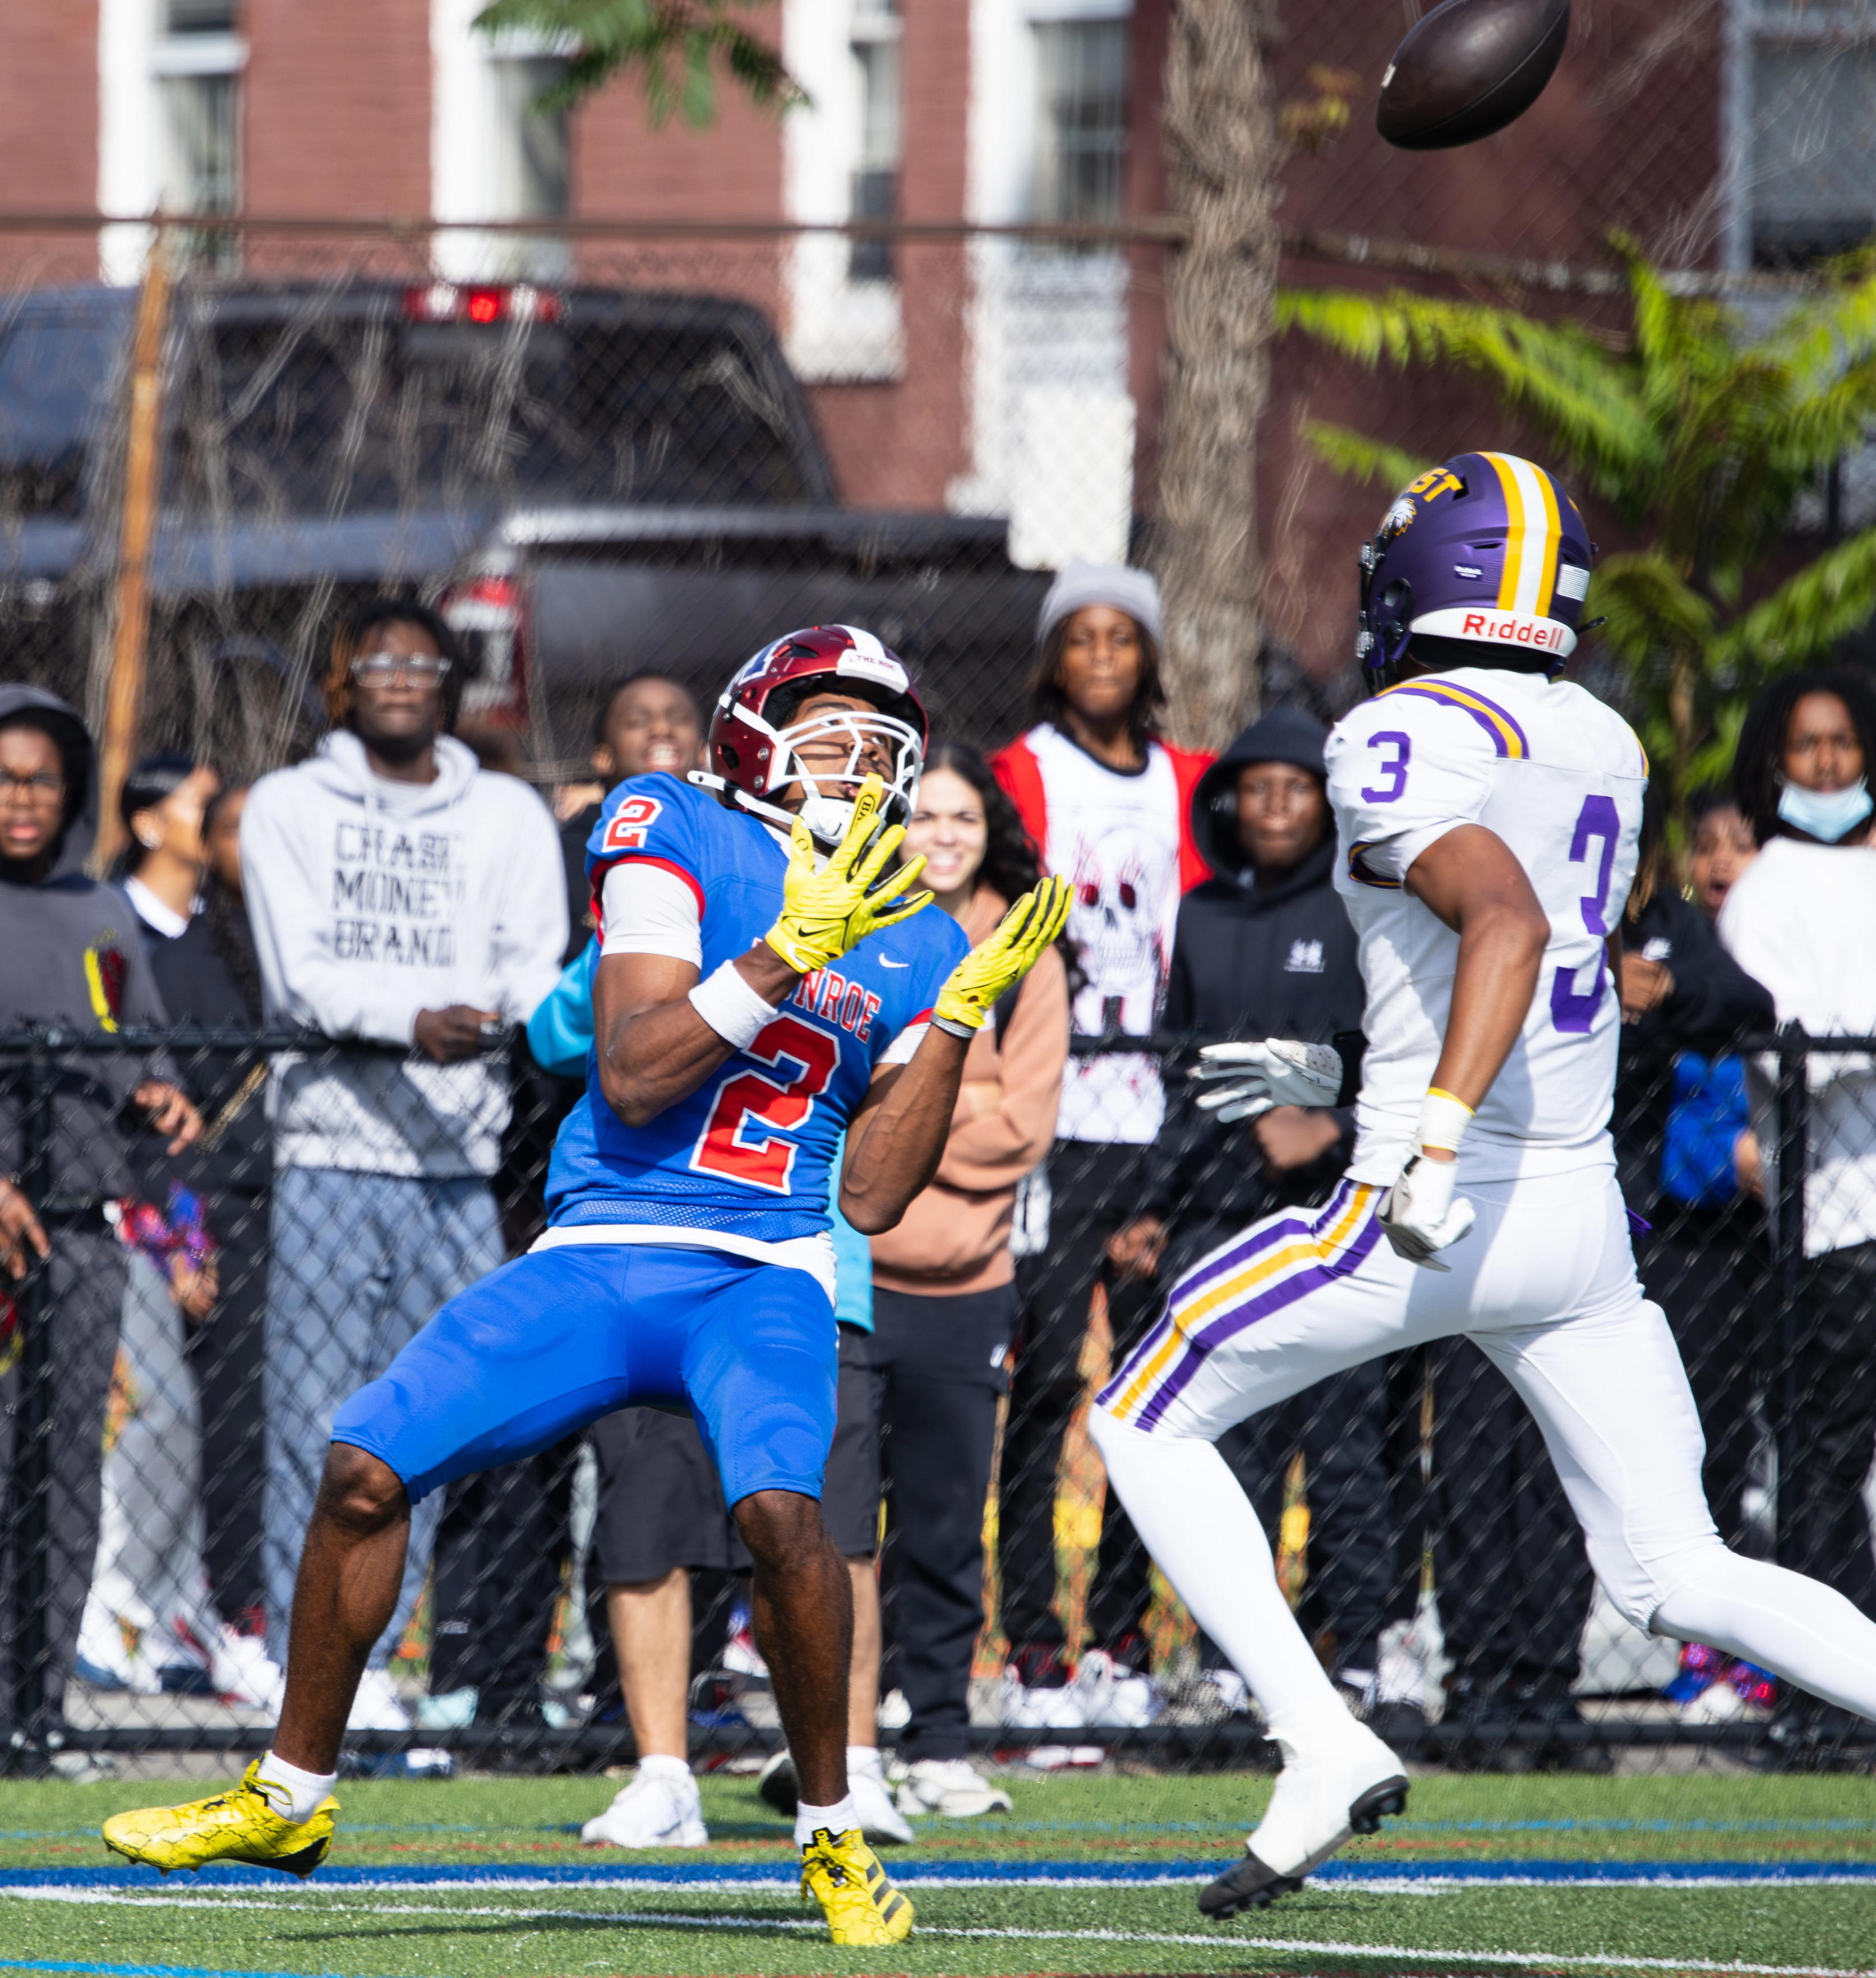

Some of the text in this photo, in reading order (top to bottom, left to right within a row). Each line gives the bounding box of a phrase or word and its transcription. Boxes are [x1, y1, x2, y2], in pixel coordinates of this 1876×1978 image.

[1463, 614, 1564, 649] Riddell
[1361, 731, 1411, 803] 3
[601, 795, 663, 852] 2
[1551, 795, 1620, 1034] 3
[783, 965, 883, 1045] NROE
[689, 1011, 841, 1195] 2
